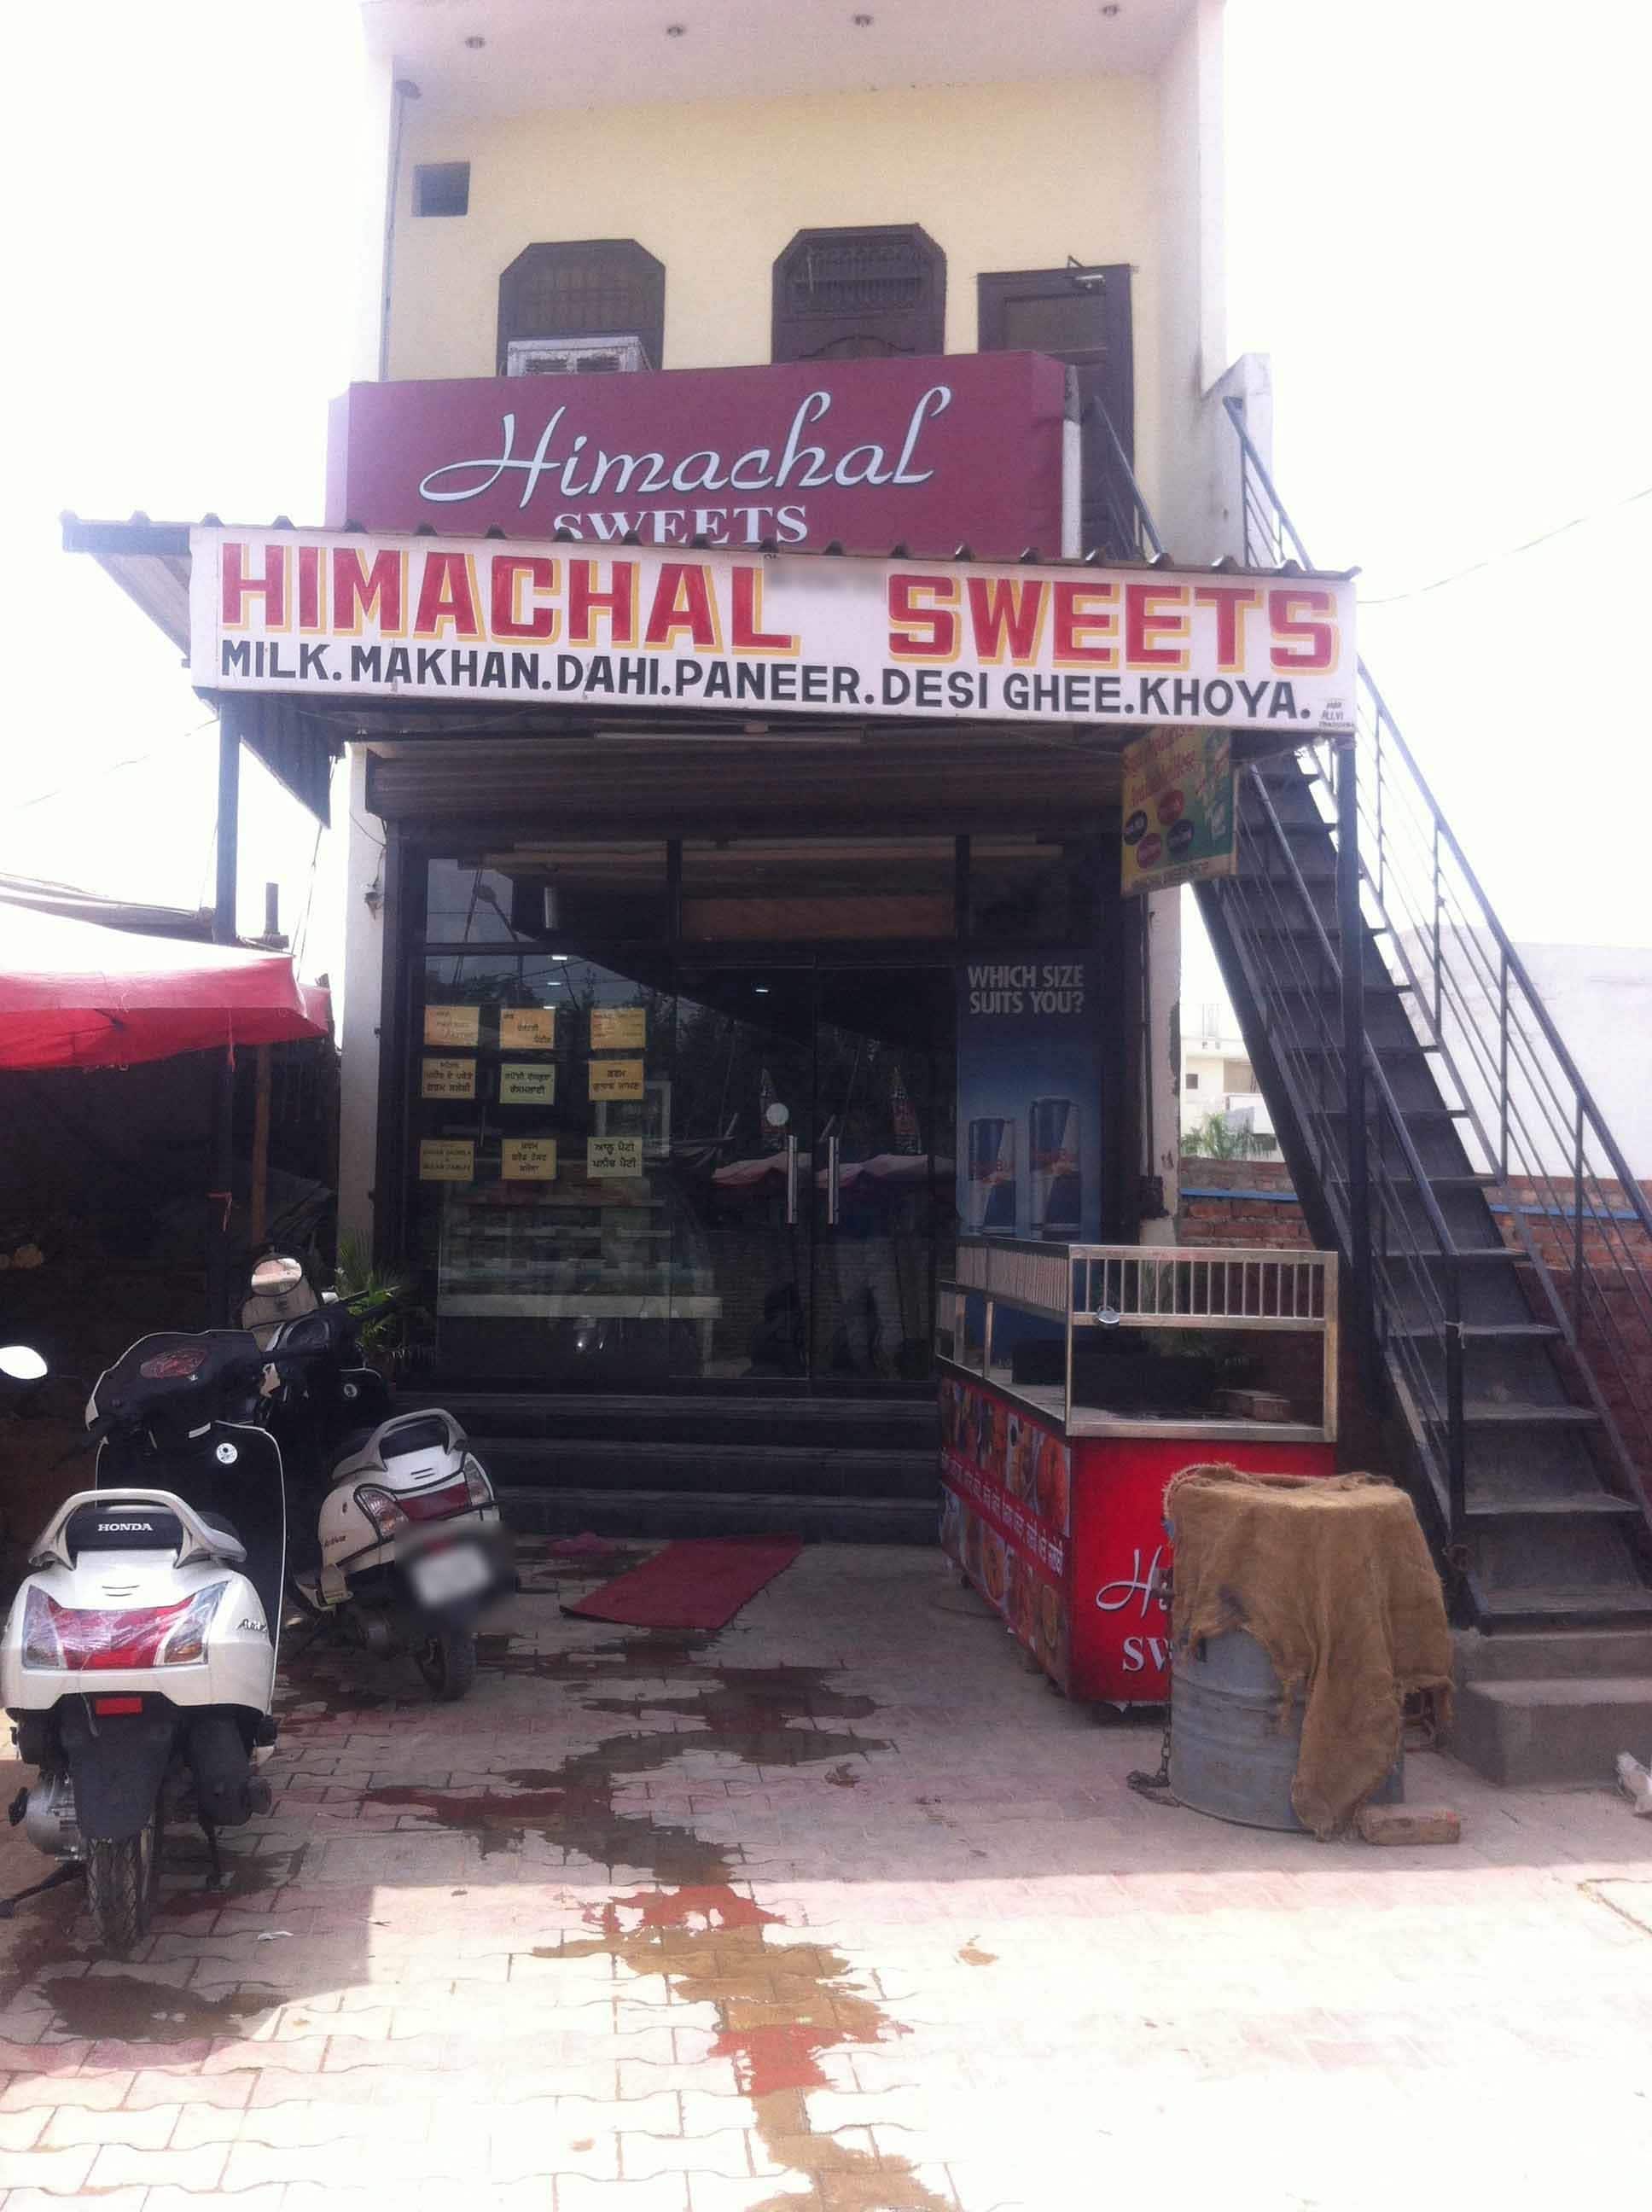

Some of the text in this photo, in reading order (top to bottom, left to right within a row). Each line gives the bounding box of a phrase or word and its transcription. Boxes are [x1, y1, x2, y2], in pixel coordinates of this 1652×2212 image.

[418, 386, 951, 509] Himachal
[553, 505, 808, 544] SWEETS
[222, 543, 1341, 677] HIMACHAL SWEETS
[968, 965, 1085, 988] WHICH SIZE
[969, 991, 1085, 1014] SUITS YOU?
[97, 1522, 154, 1532] HONDA
